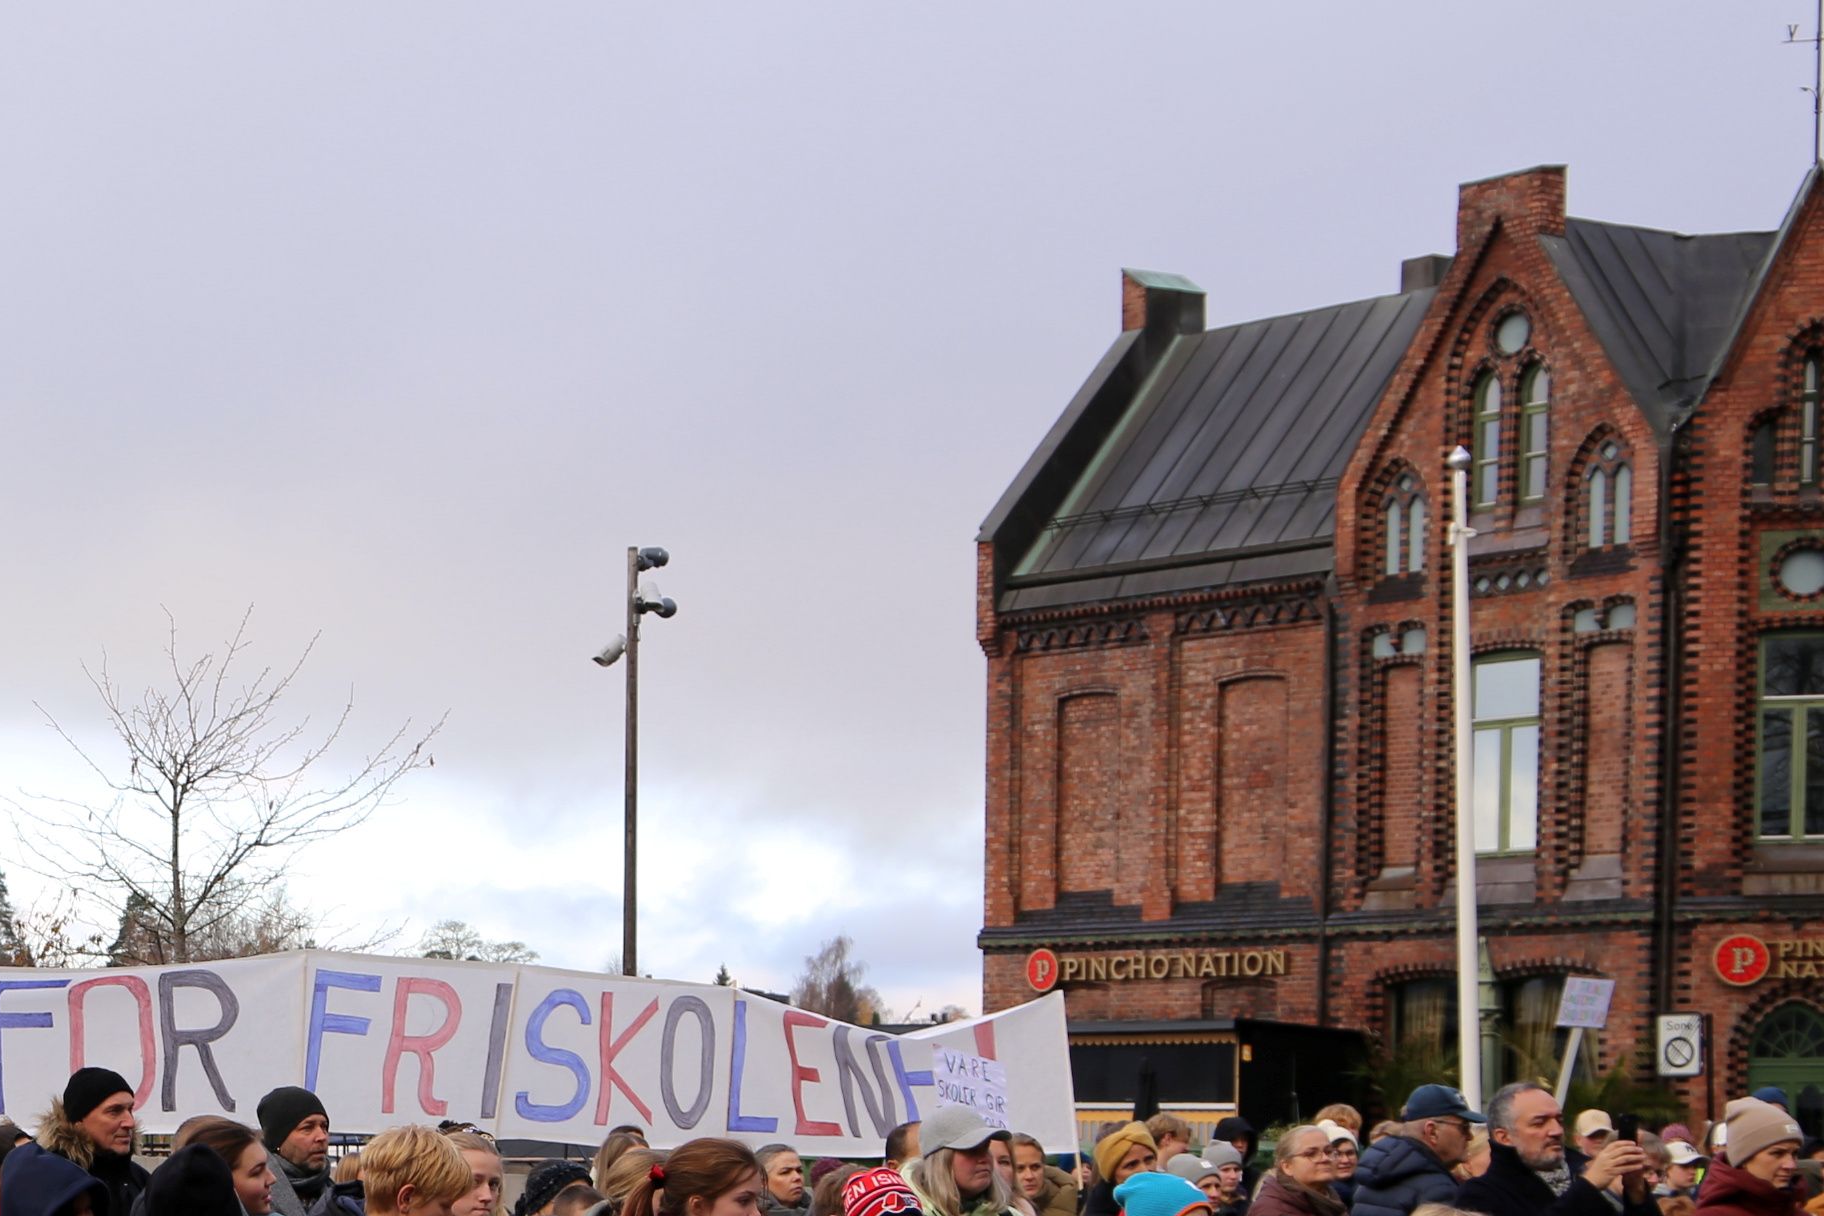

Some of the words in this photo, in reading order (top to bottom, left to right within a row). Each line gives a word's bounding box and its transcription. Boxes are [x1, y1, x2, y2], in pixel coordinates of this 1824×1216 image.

[1064, 955, 1169, 981] PINCHO
[1179, 951, 1285, 977] NATION
[1666, 1020, 1694, 1032] Sone
[937, 1079, 977, 1107] SKOLER
